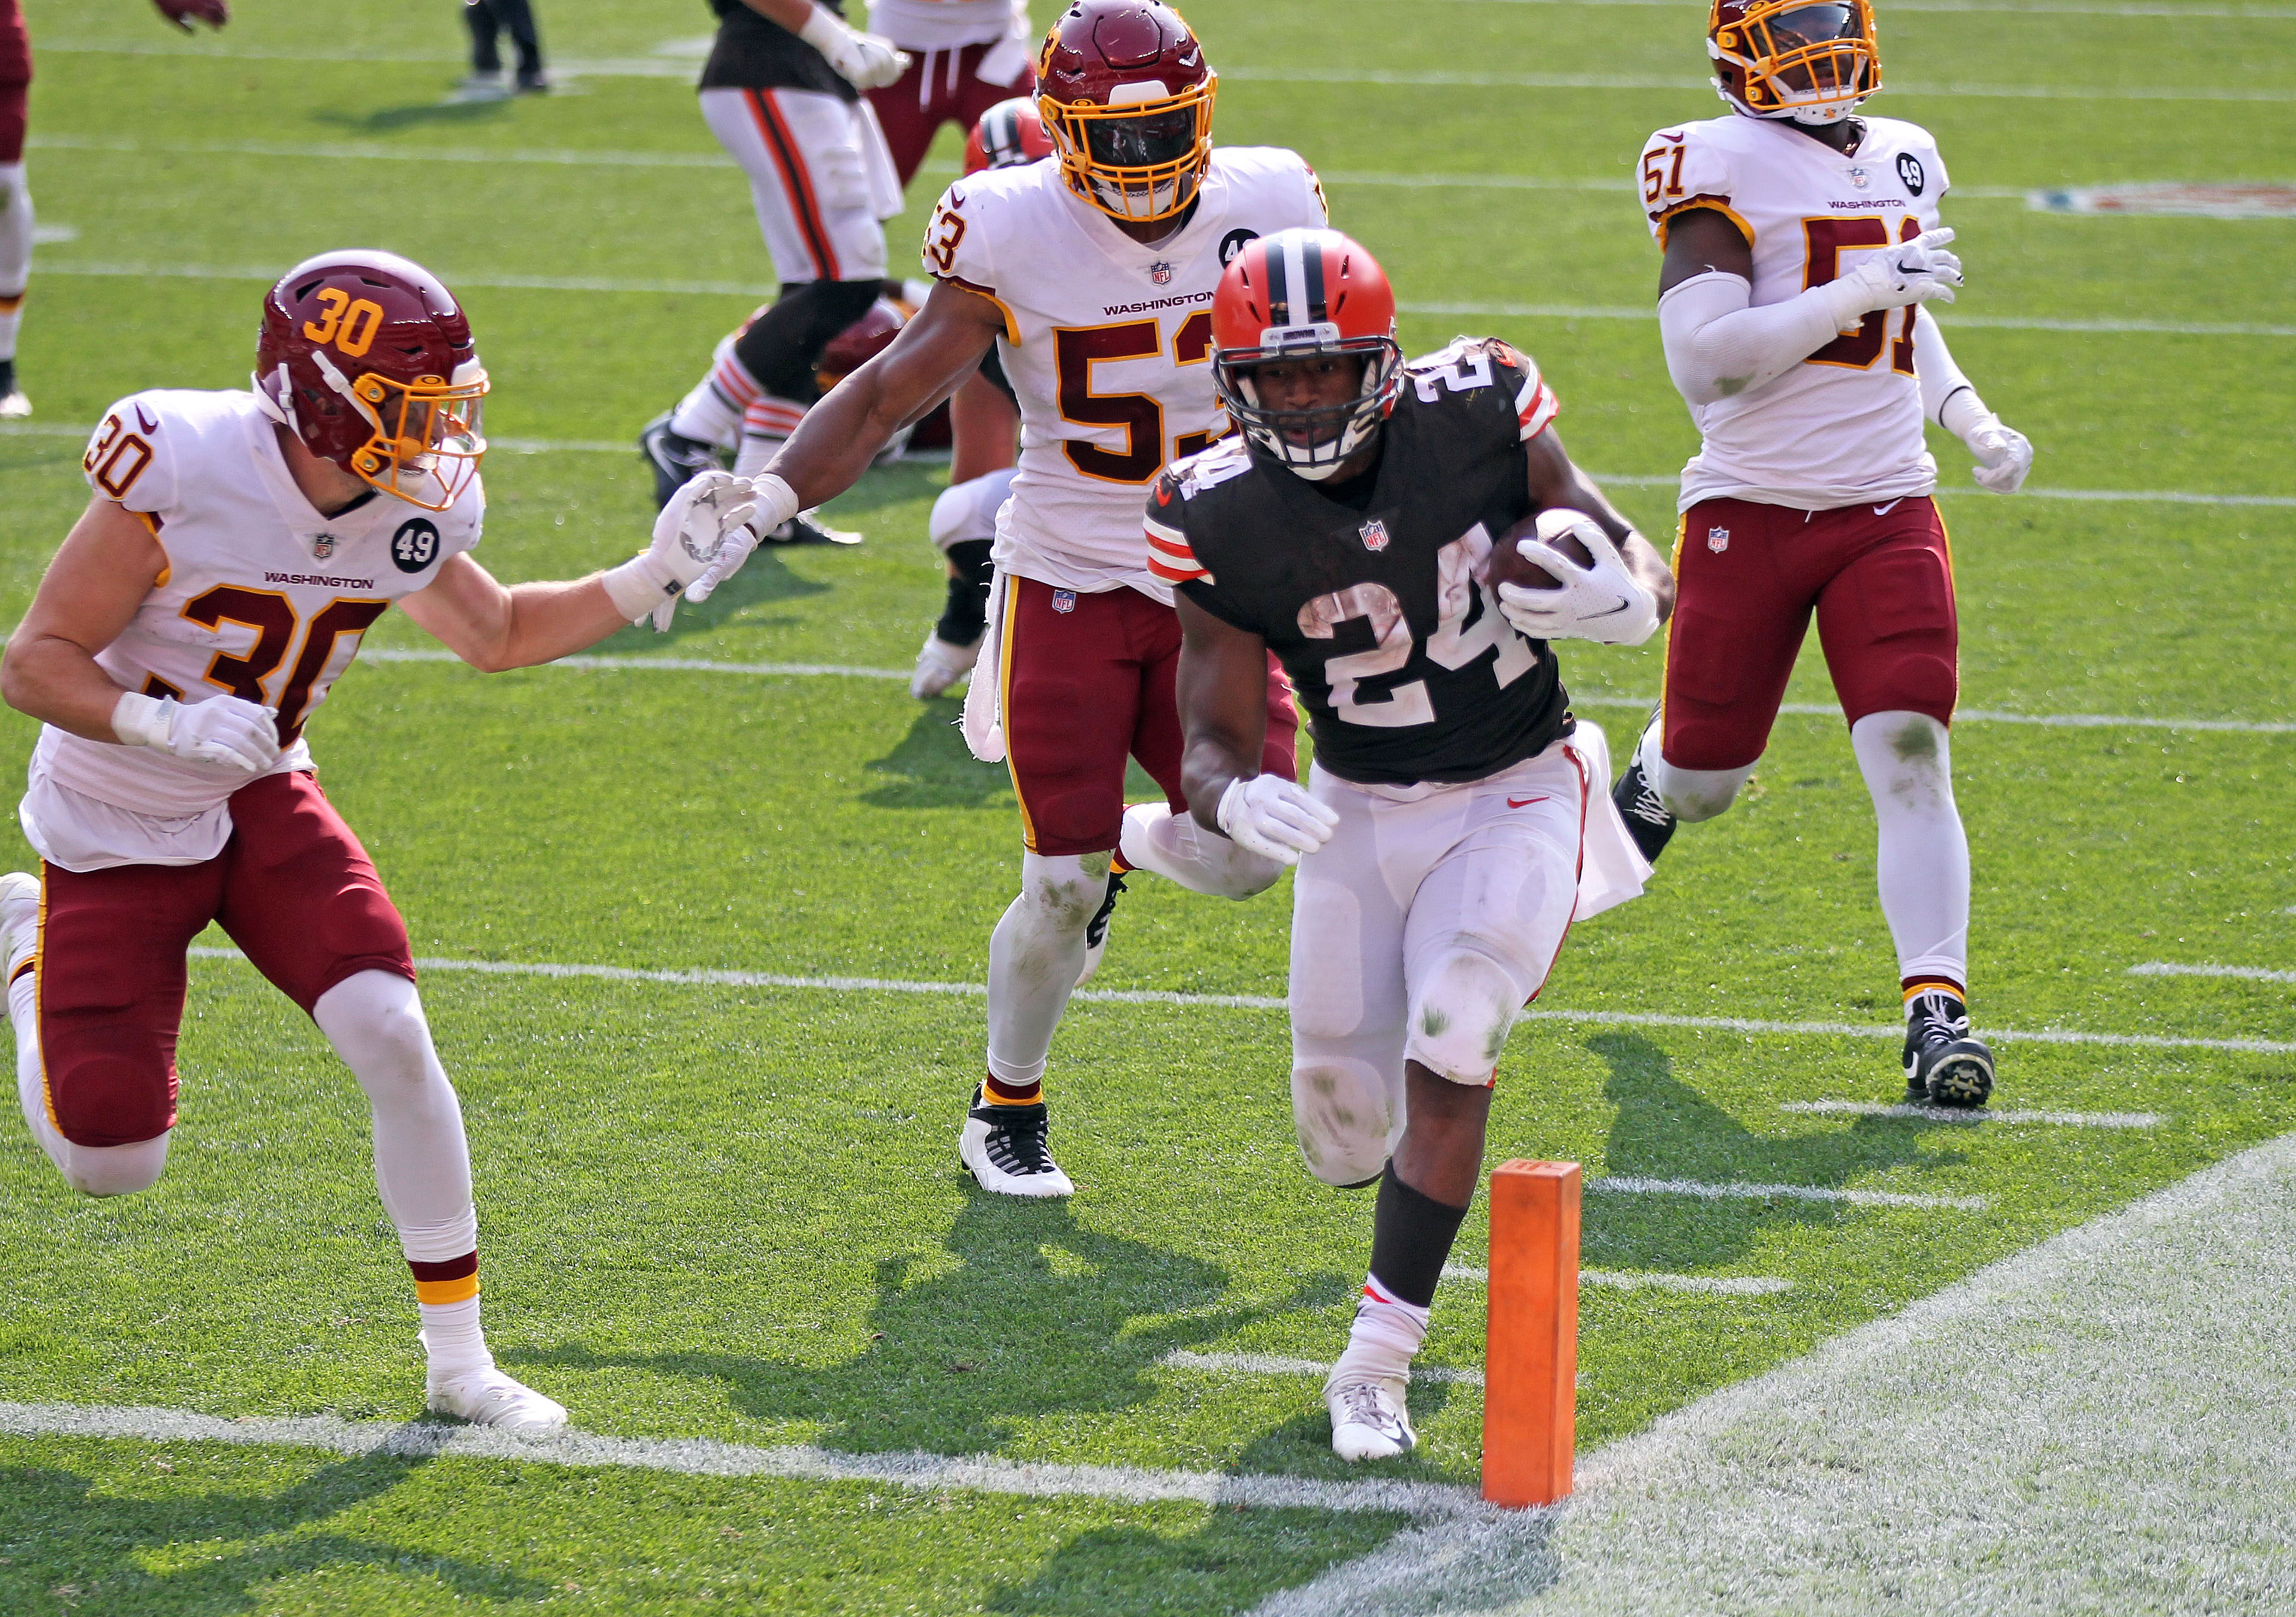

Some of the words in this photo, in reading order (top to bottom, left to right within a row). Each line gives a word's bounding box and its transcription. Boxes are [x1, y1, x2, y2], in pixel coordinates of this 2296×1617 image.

[1644, 146, 1686, 204] 51
[1900, 159, 1922, 187] 49
[1827, 199, 1906, 209] WASHINGTON
[1225, 238, 1256, 262] 4
[1153, 270, 1170, 283] NFL
[303, 287, 384, 358] 30
[82, 413, 155, 501] 30
[396, 529, 435, 562] 49
[1367, 532, 1386, 547] NFL
[263, 571, 374, 589] WASHINGTON
[1056, 598, 1072, 609] NFL
[1297, 522, 1538, 727] 24
[141, 583, 390, 752] 30
